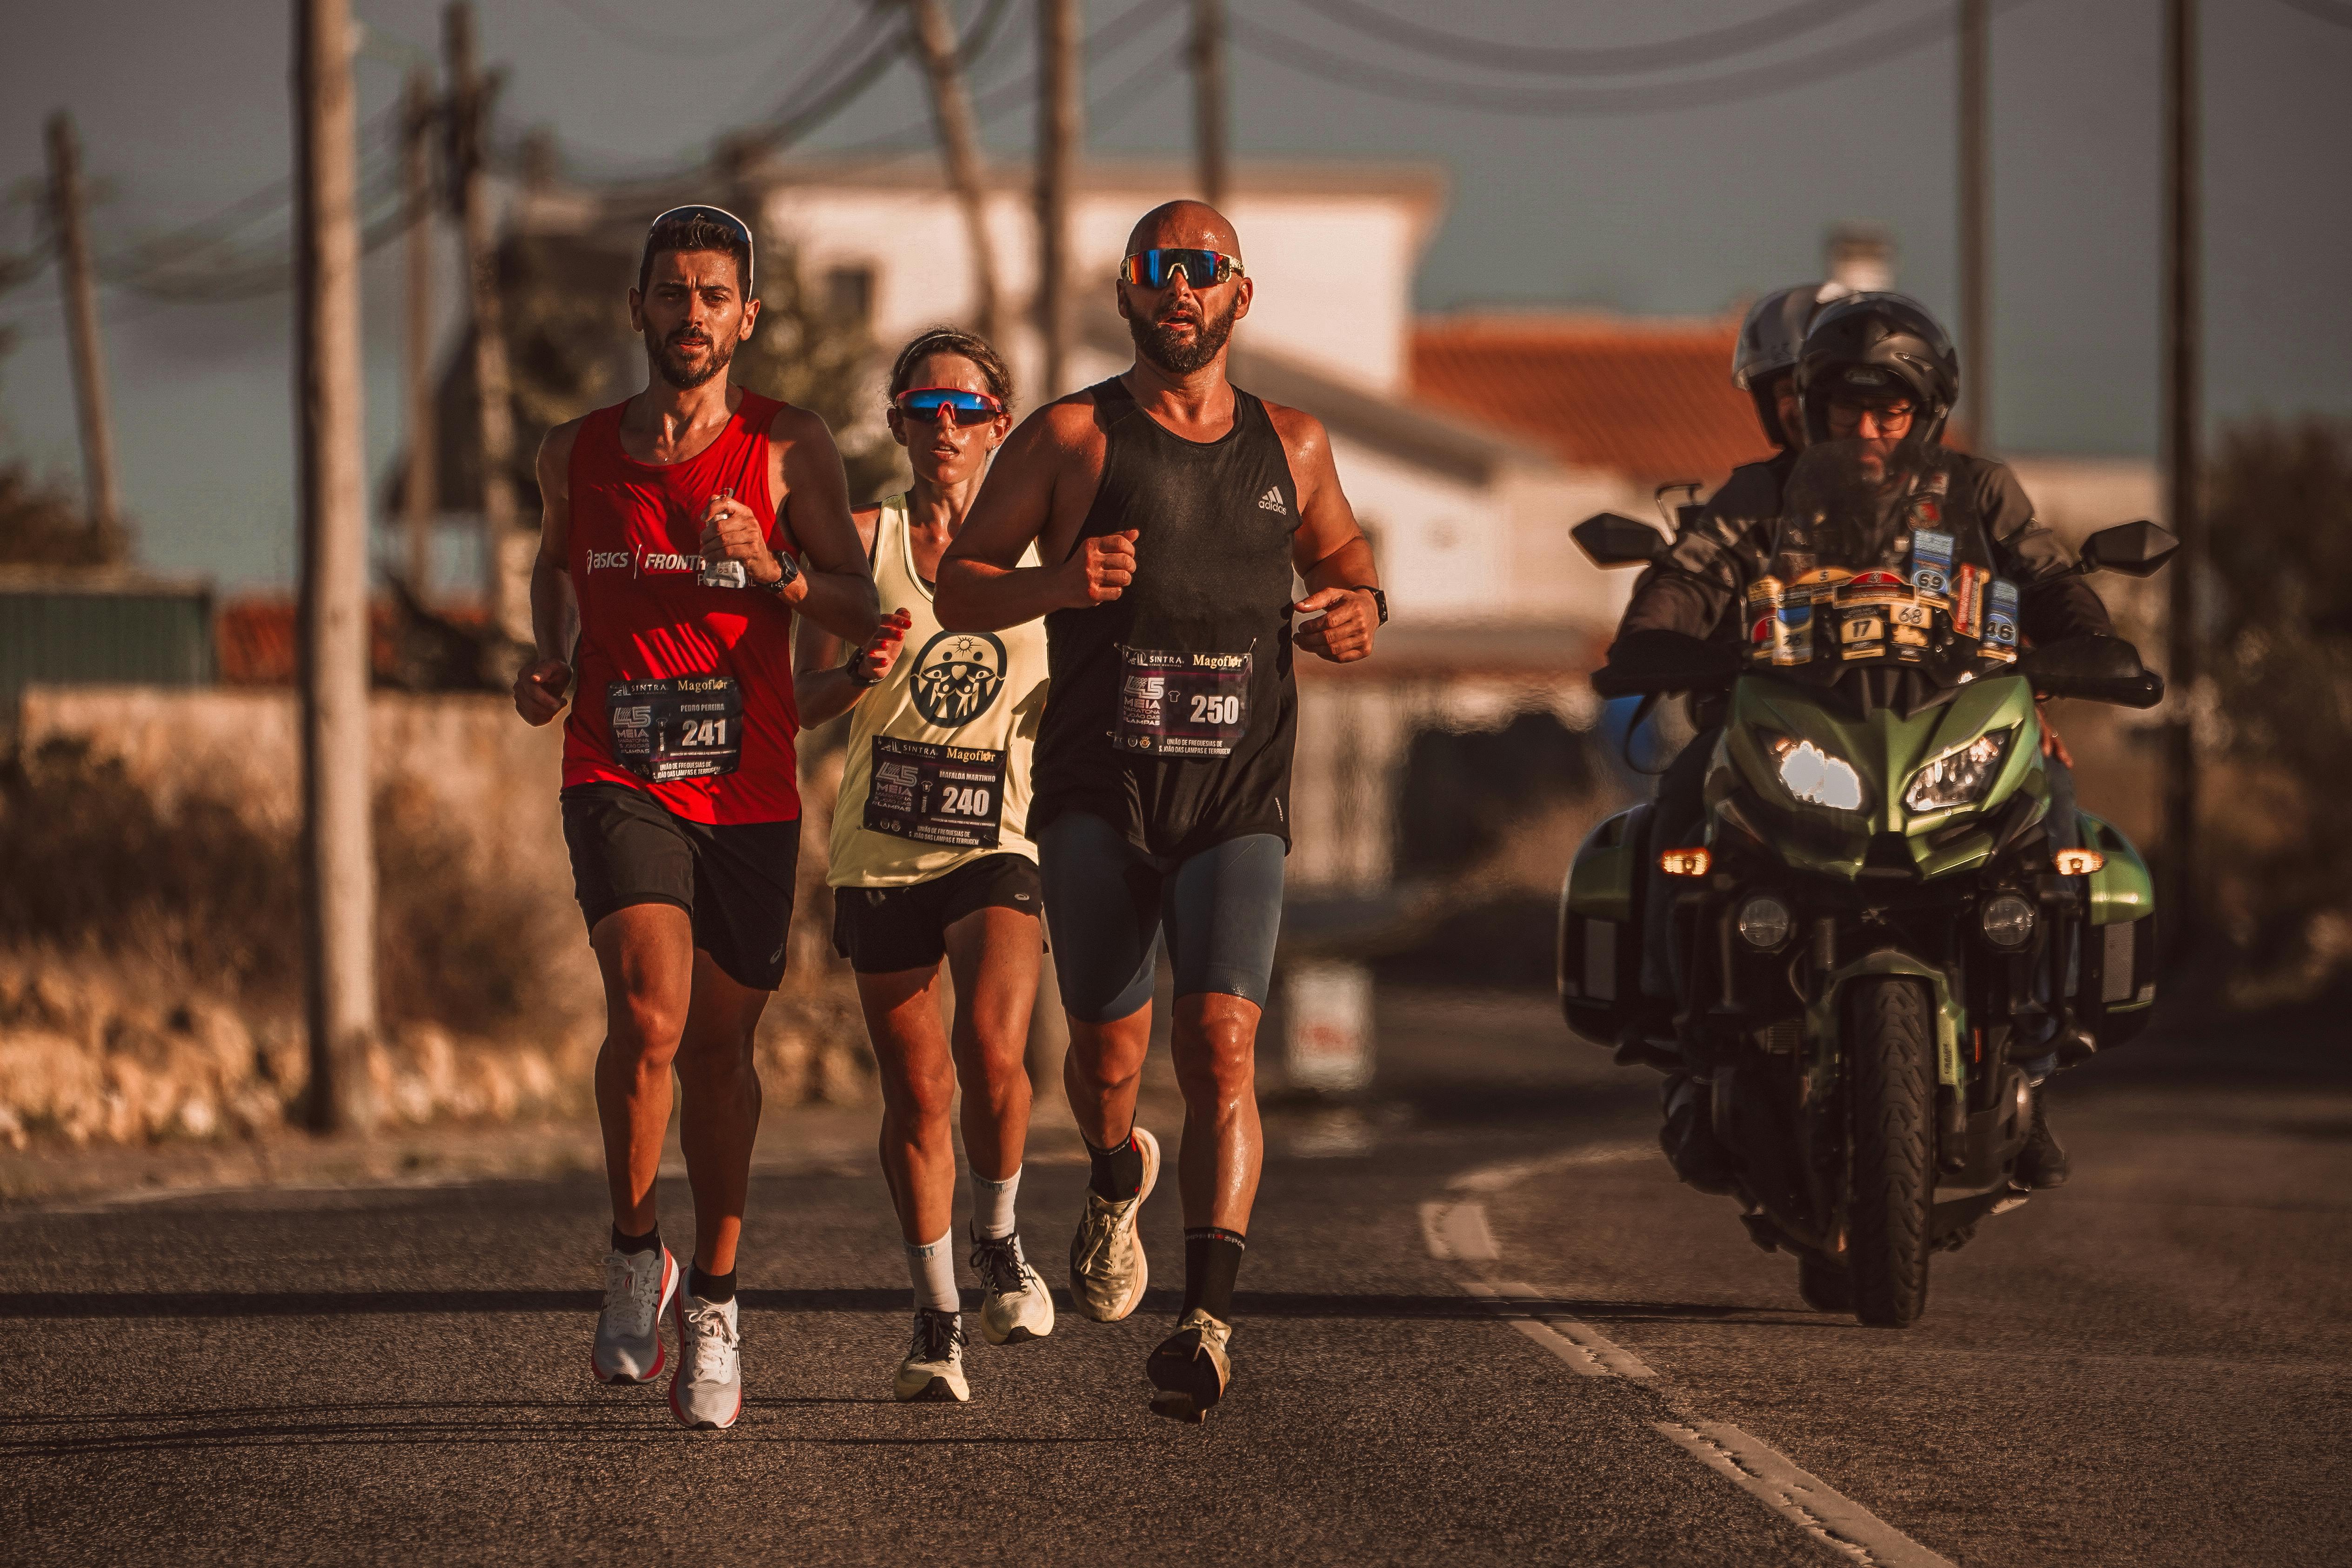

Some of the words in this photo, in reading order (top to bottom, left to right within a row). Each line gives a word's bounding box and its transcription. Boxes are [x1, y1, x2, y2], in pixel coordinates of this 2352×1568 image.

[1258, 500, 1287, 515] adidas
[645, 554, 707, 571] FRONTR
[1898, 607, 1923, 626] 68
[1852, 620, 1872, 638] 17
[1149, 655, 1182, 664] SINTRA
[1193, 654, 1243, 669] Magoflor
[1124, 696, 1161, 709] MEIA
[1190, 695, 1239, 724] 250
[616, 728, 649, 738] MEIA
[682, 719, 726, 746] 241
[903, 745, 936, 756] SINTRA
[946, 747, 996, 762] Magoflor
[657, 770, 667, 779] JOÃO
[939, 770, 965, 780] MAFALDA
[966, 773, 996, 782] MARTINHO
[876, 782, 912, 797] MEIA
[941, 786, 990, 817] 240
[937, 828, 963, 837] FREGUESIAS
